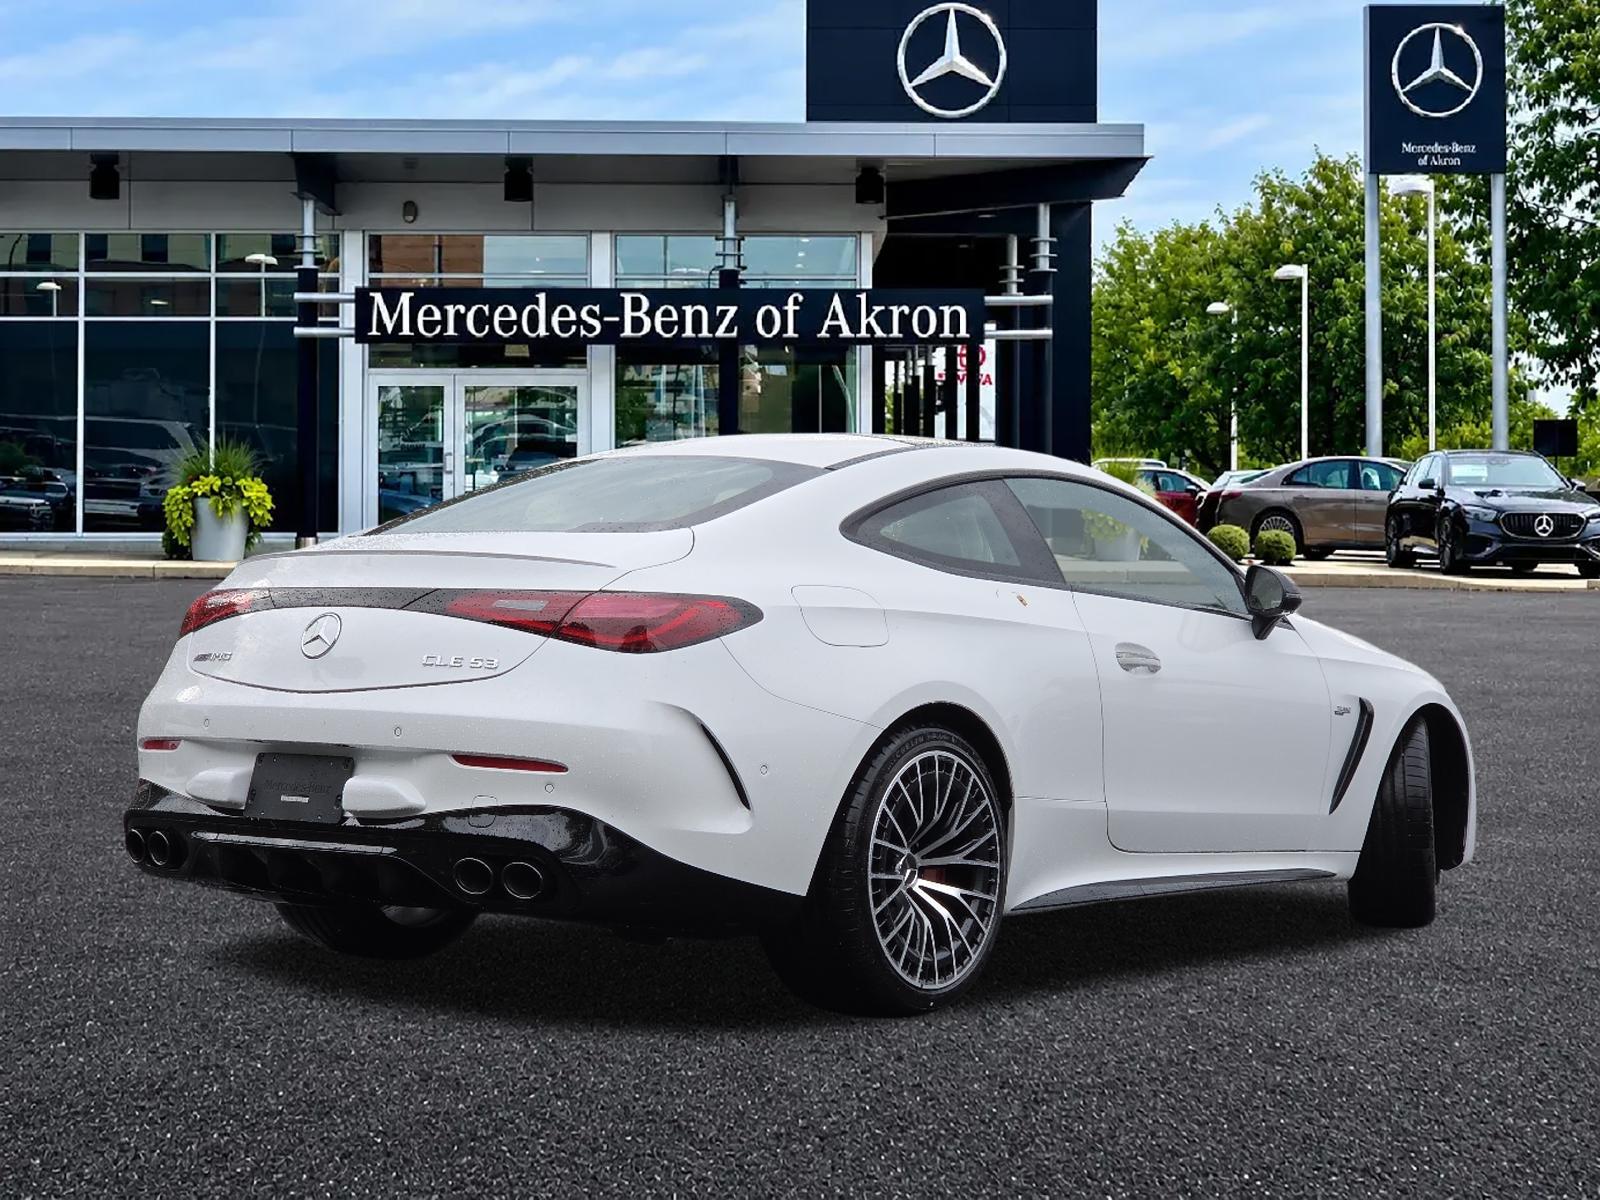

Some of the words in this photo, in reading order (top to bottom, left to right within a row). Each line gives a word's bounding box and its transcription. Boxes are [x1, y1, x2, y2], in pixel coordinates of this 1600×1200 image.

[1401, 142, 1476, 153] Mercedes-Benz
[1417, 155, 1429, 166] of
[1430, 155, 1461, 166] Akron
[367, 291, 738, 338] Mercedes-Benz
[756, 292, 804, 338] of
[816, 292, 970, 338] Akron
[422, 655, 464, 667] CLE
[470, 657, 499, 669] 53
